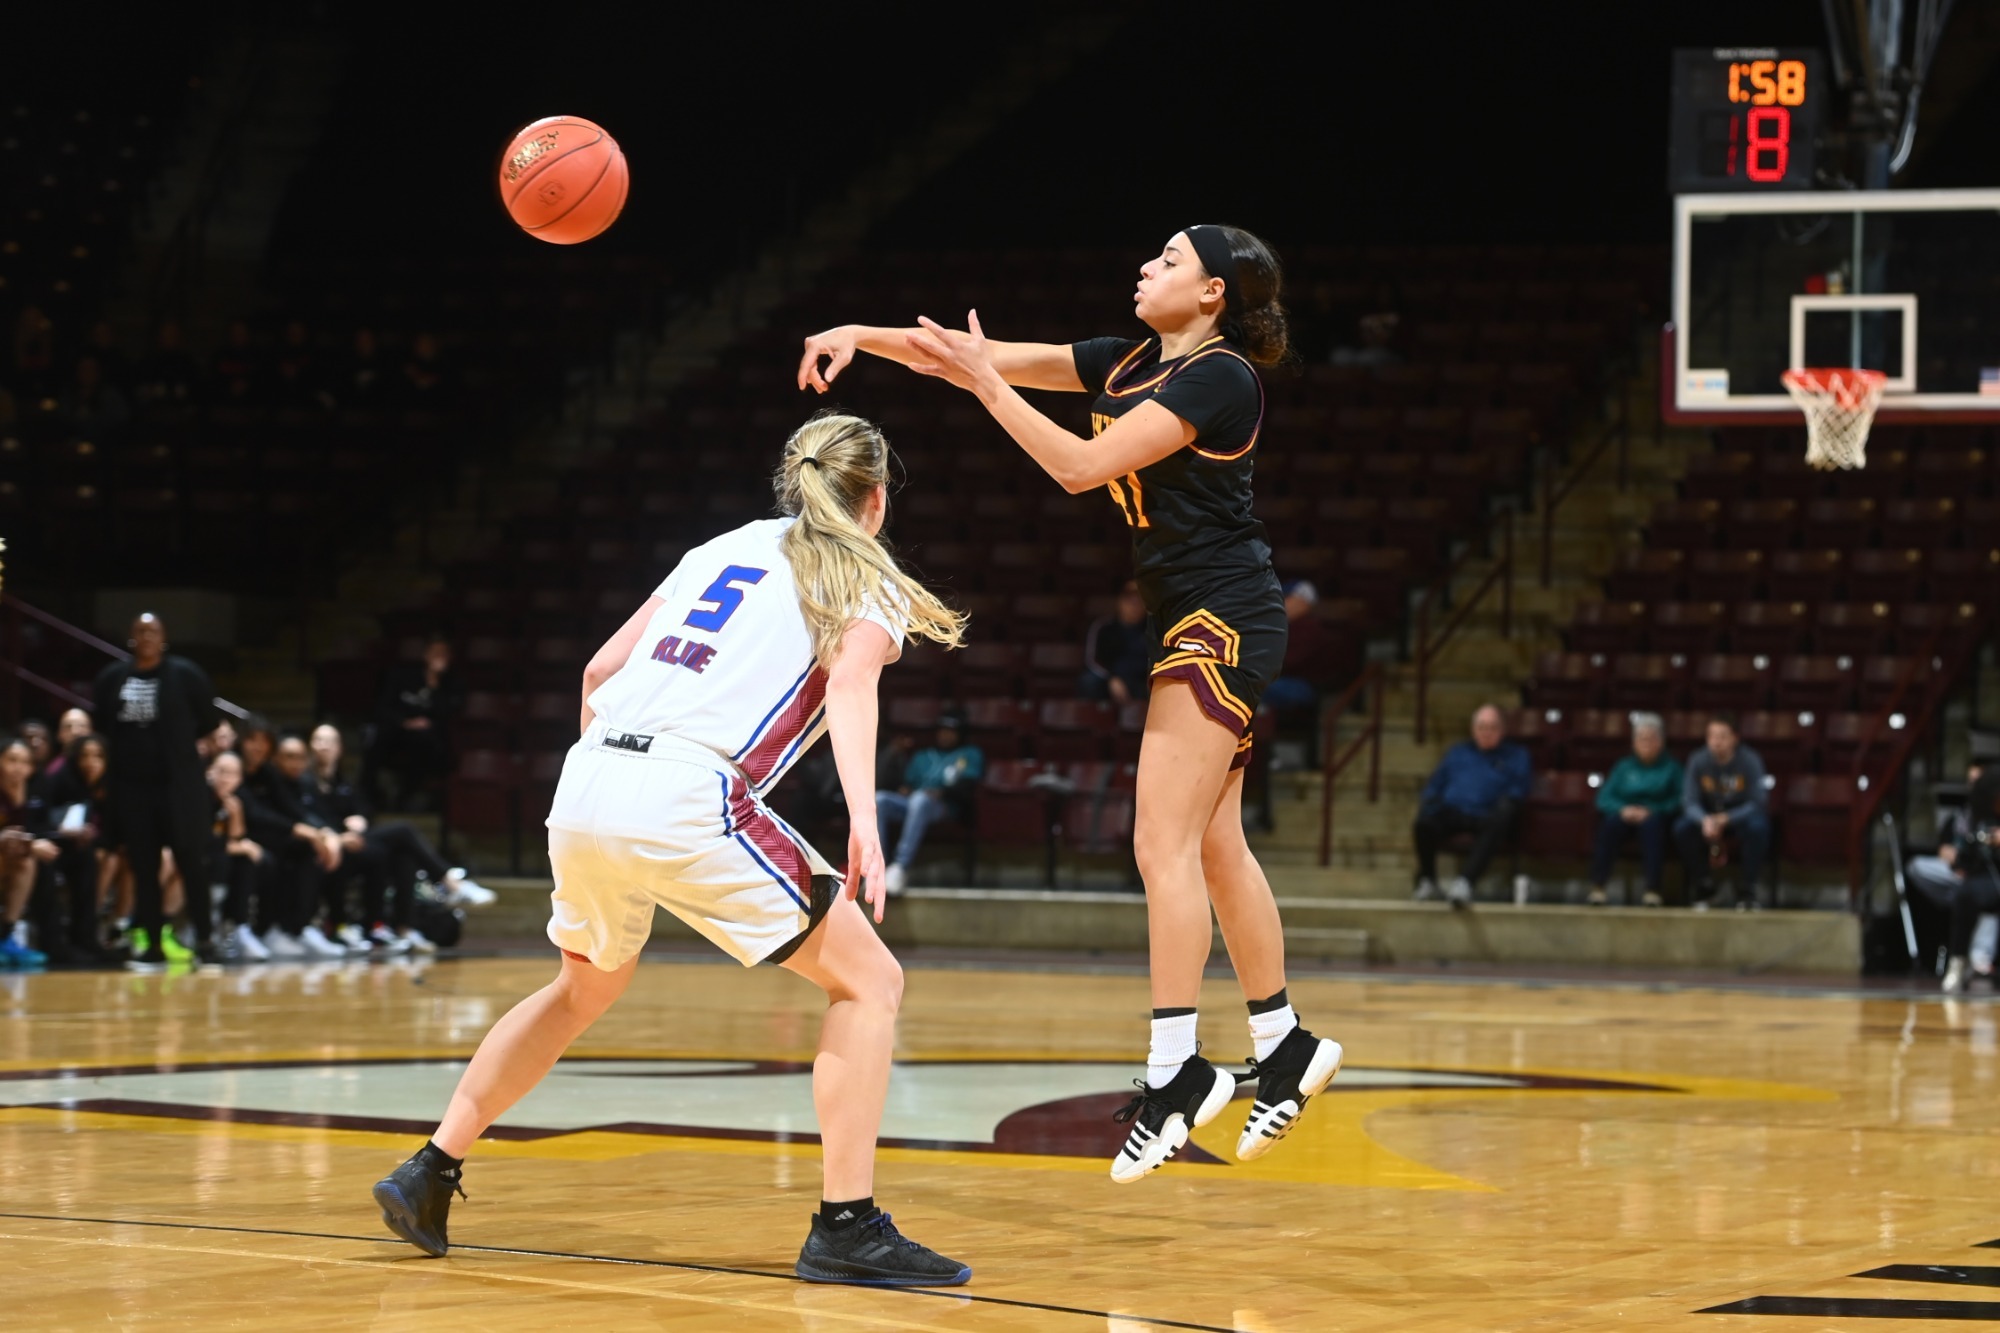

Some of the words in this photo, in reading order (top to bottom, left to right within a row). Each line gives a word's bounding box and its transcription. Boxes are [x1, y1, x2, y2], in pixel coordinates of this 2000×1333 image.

[1728, 60, 1806, 106] 1:58
[681, 564, 769, 633] 5
[650, 634, 718, 675] KLINE
